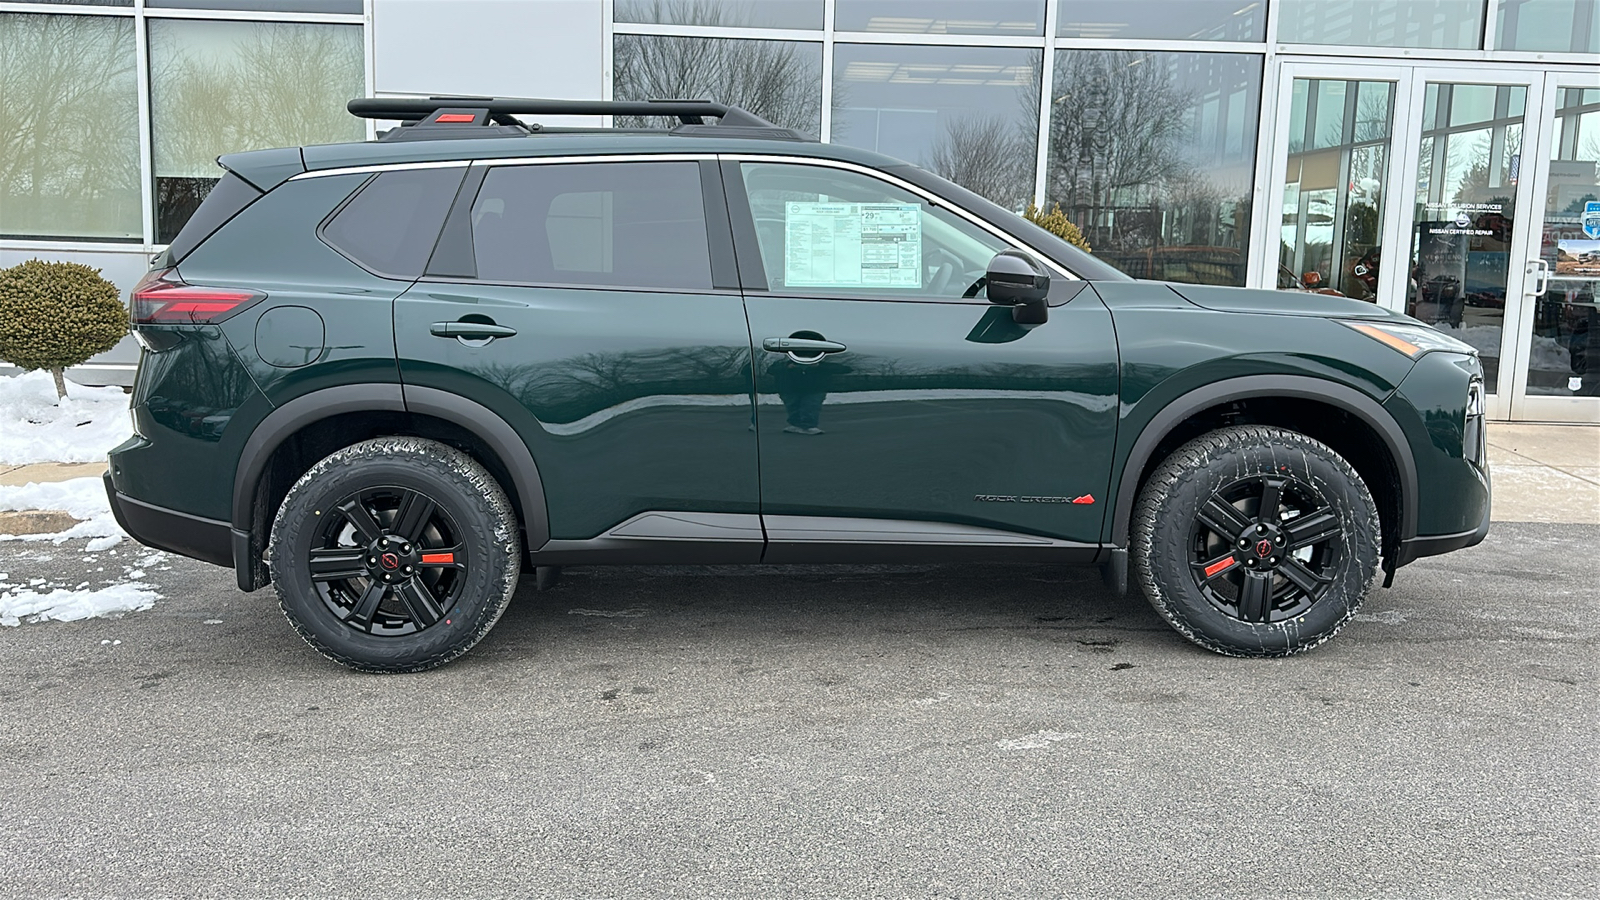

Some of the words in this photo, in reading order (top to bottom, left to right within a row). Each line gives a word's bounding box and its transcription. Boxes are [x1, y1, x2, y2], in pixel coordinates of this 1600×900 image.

[865, 212, 875, 220] 29
[974, 494, 1018, 503] ROCK
[1019, 495, 1072, 504] CREEK
